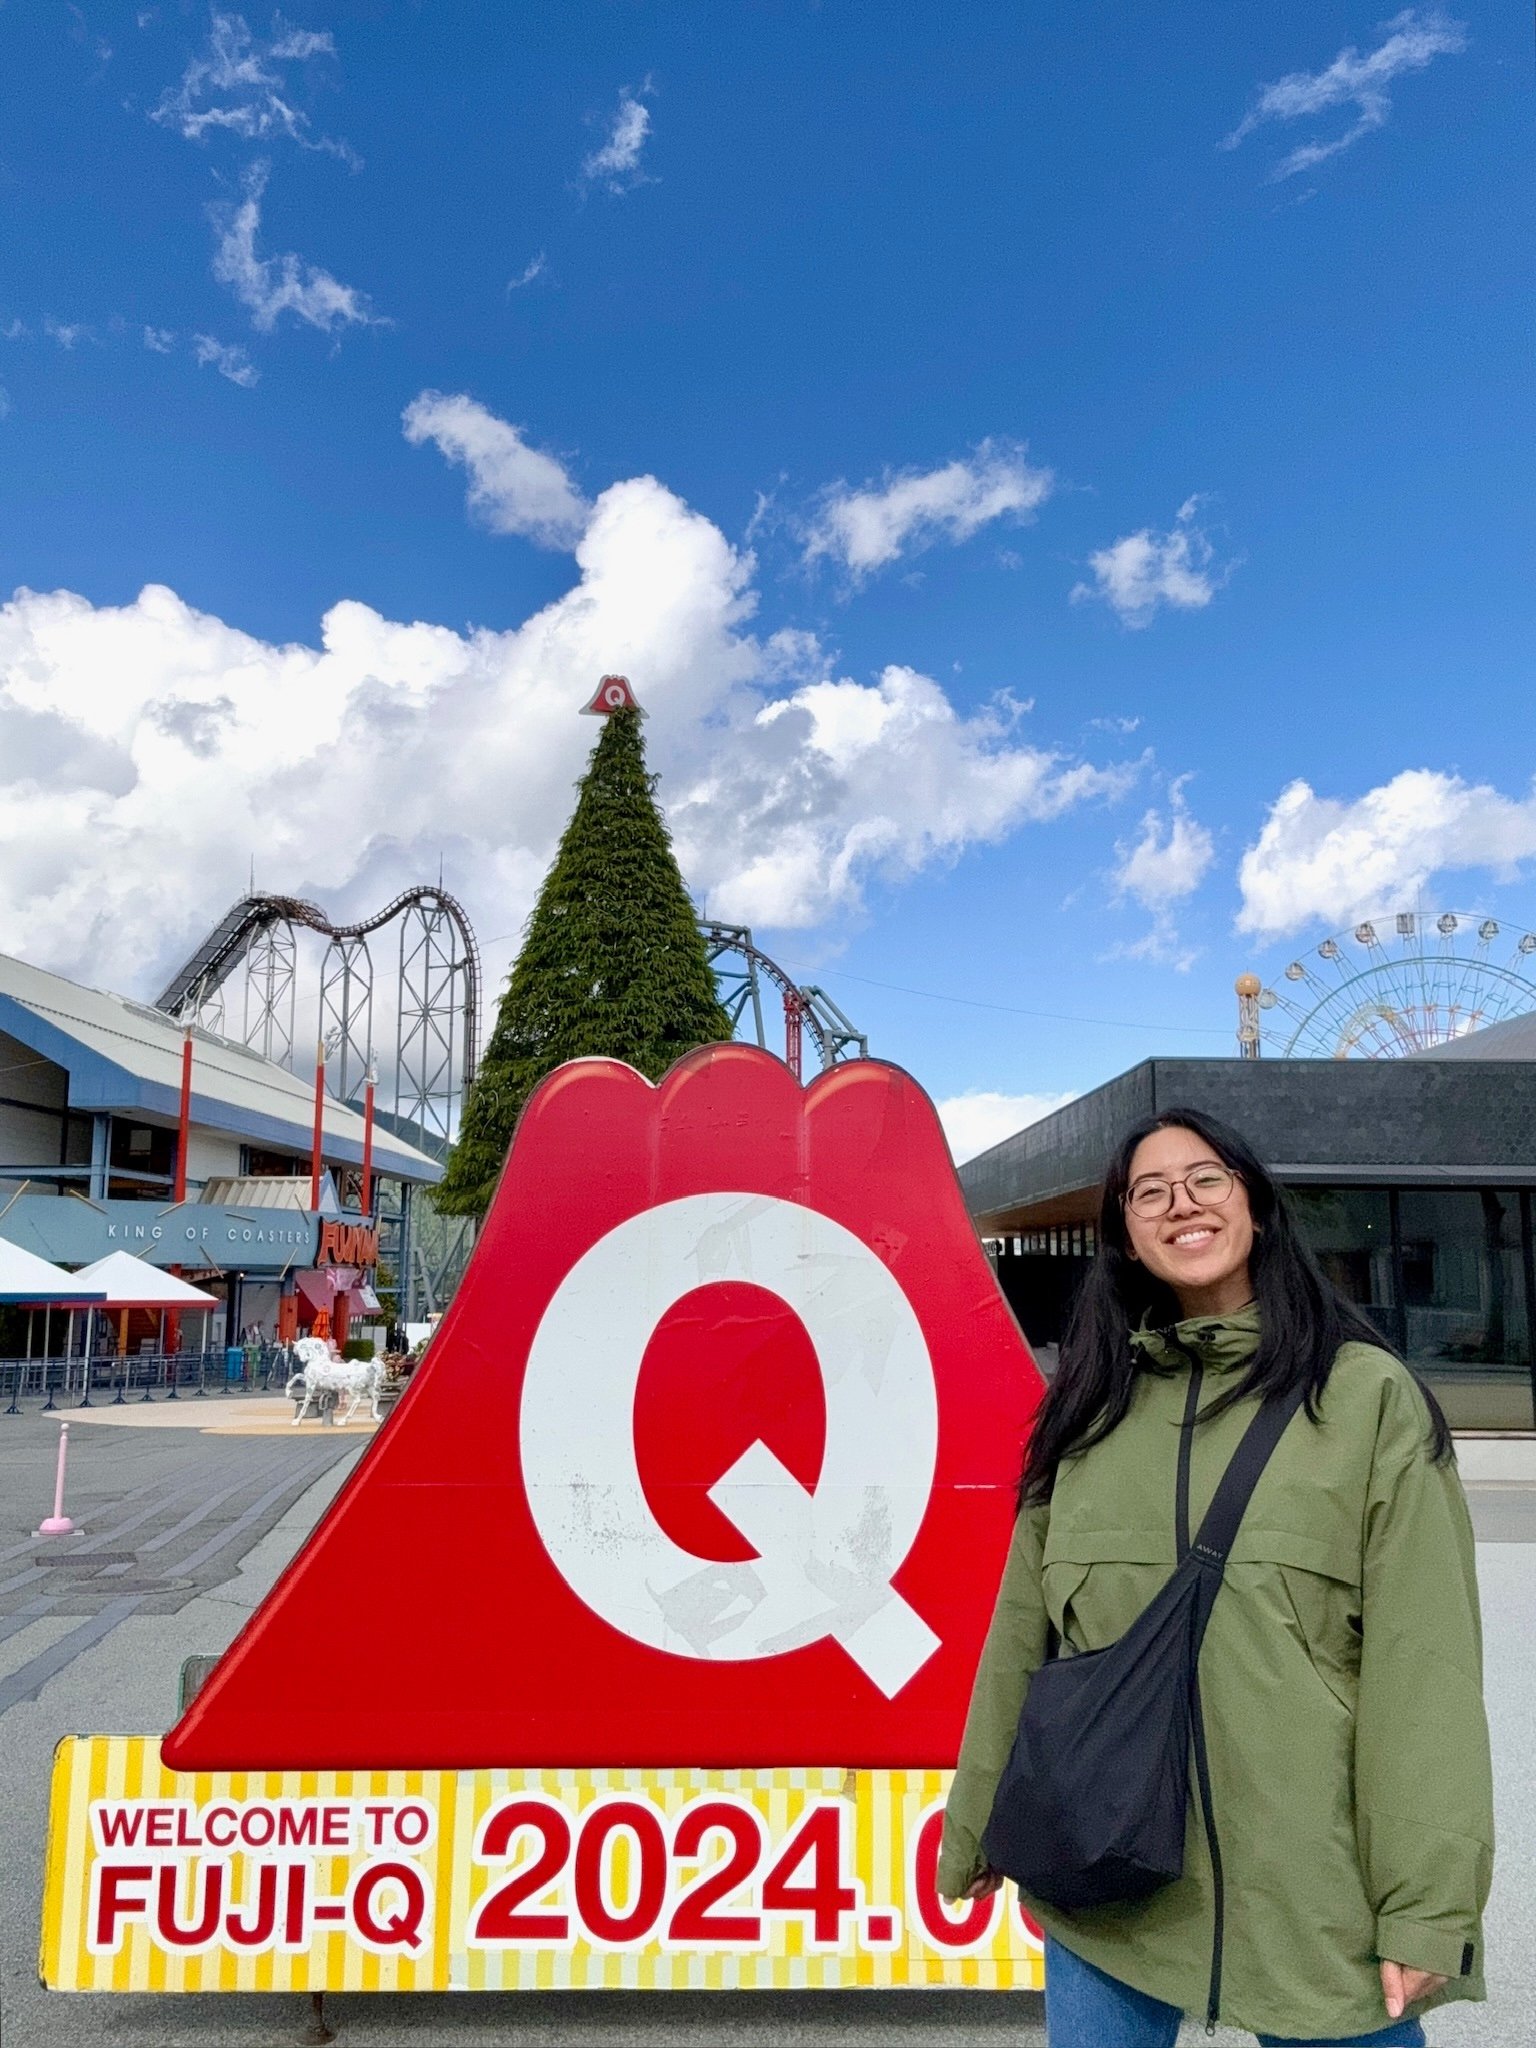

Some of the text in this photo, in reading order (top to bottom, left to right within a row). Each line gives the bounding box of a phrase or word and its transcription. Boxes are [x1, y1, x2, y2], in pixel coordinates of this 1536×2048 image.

[604, 685, 626, 708] Q
[108, 1225, 310, 1244] KING OF COASTERS
[519, 1191, 943, 1701] Q
[1196, 1543, 1223, 1559] AWAY
[99, 1806, 429, 1847] WELCOME TO
[475, 1801, 1045, 1946] 2024.0
[96, 1863, 425, 1950] FUJI-Q
